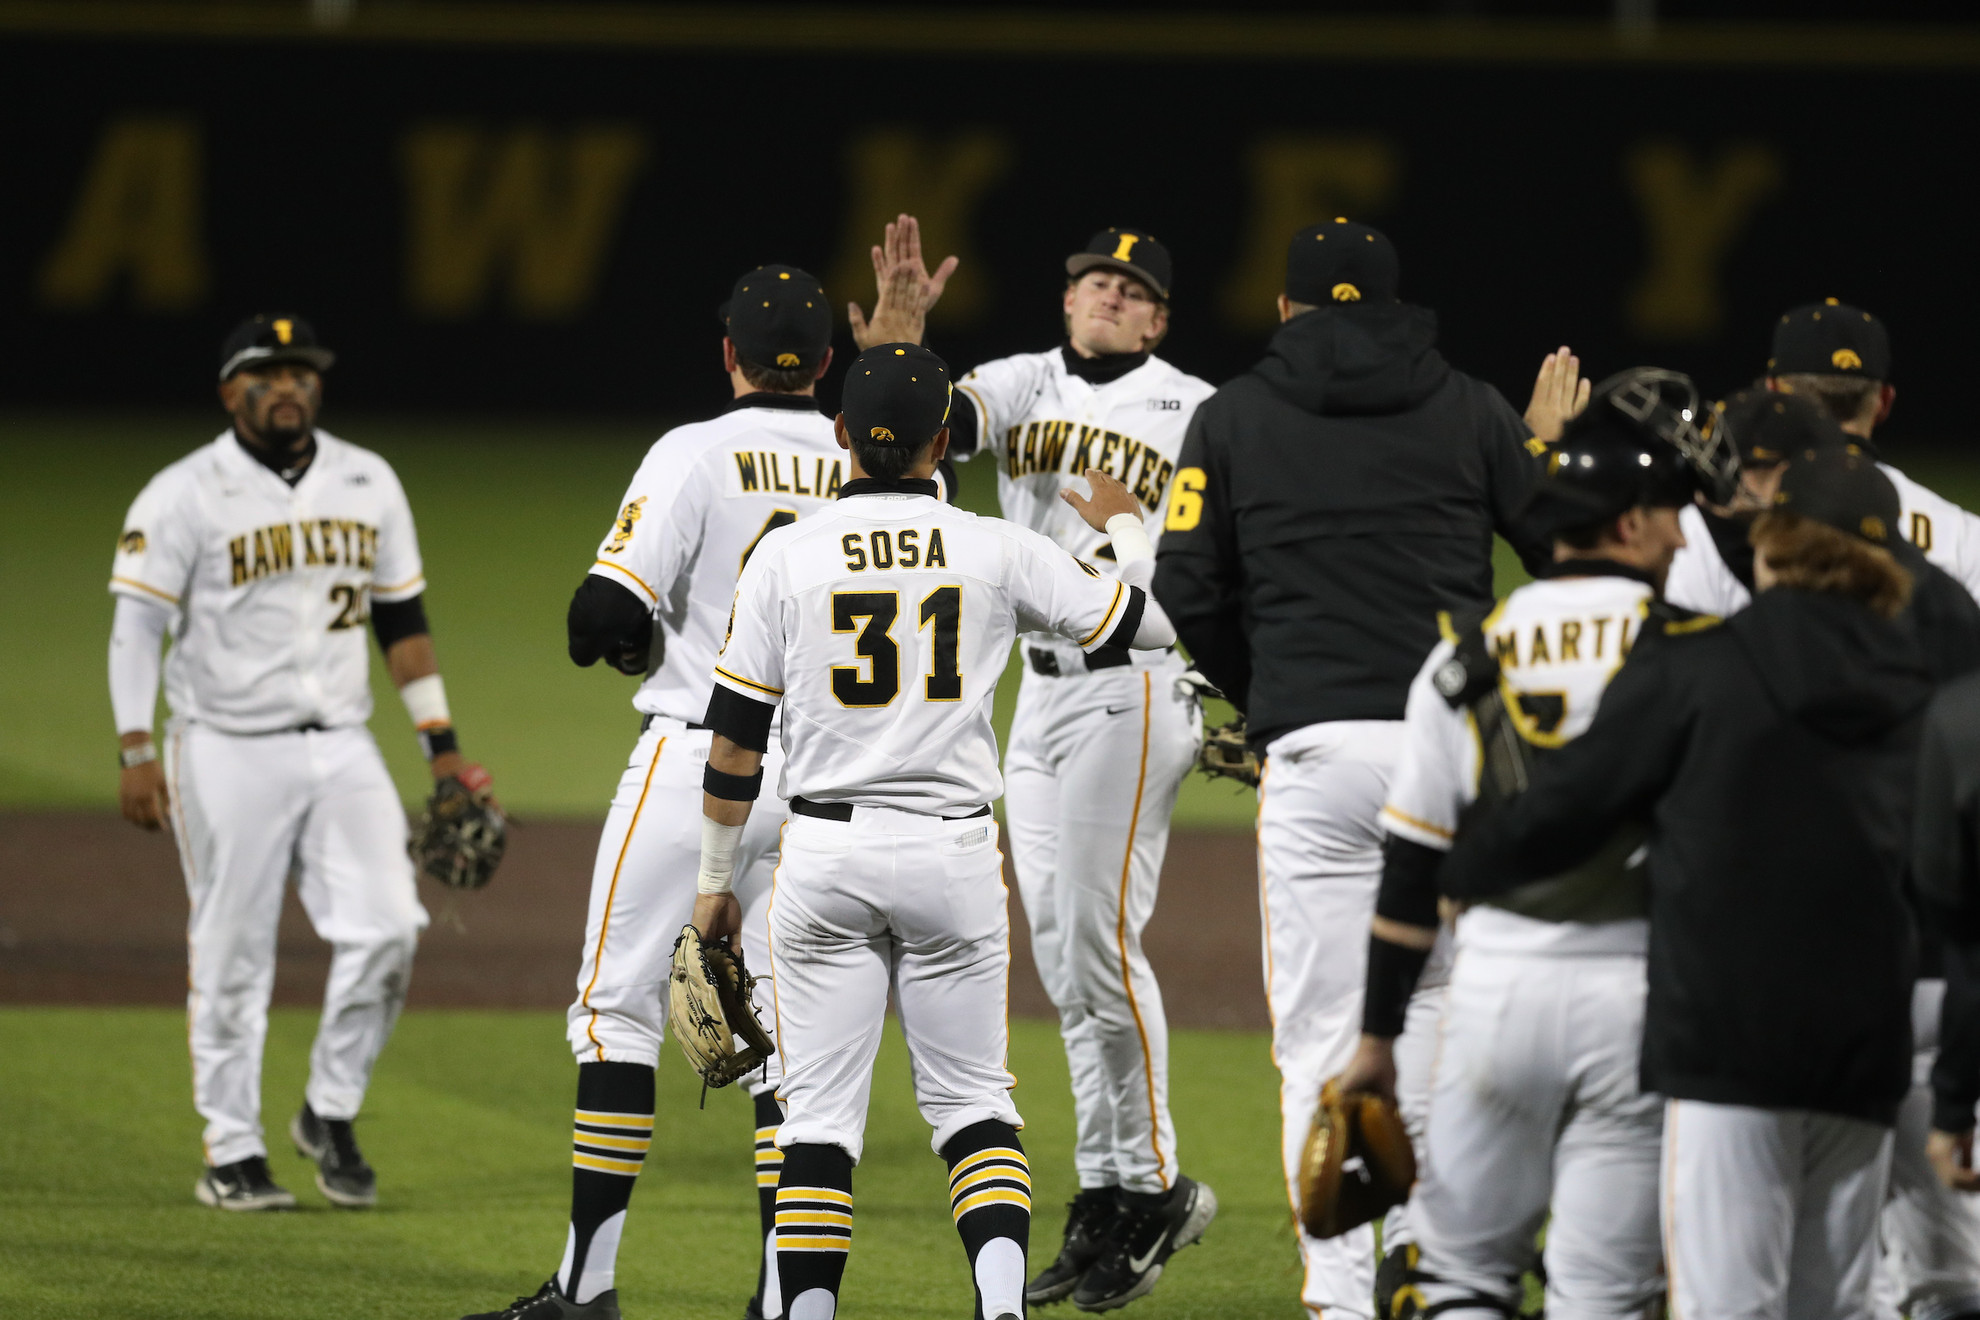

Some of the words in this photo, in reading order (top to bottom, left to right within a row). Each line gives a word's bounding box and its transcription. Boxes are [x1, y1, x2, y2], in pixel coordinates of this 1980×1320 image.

[734, 451, 844, 499] WILLIA
[841, 528, 948, 572] SOSA
[830, 584, 963, 708] 31
